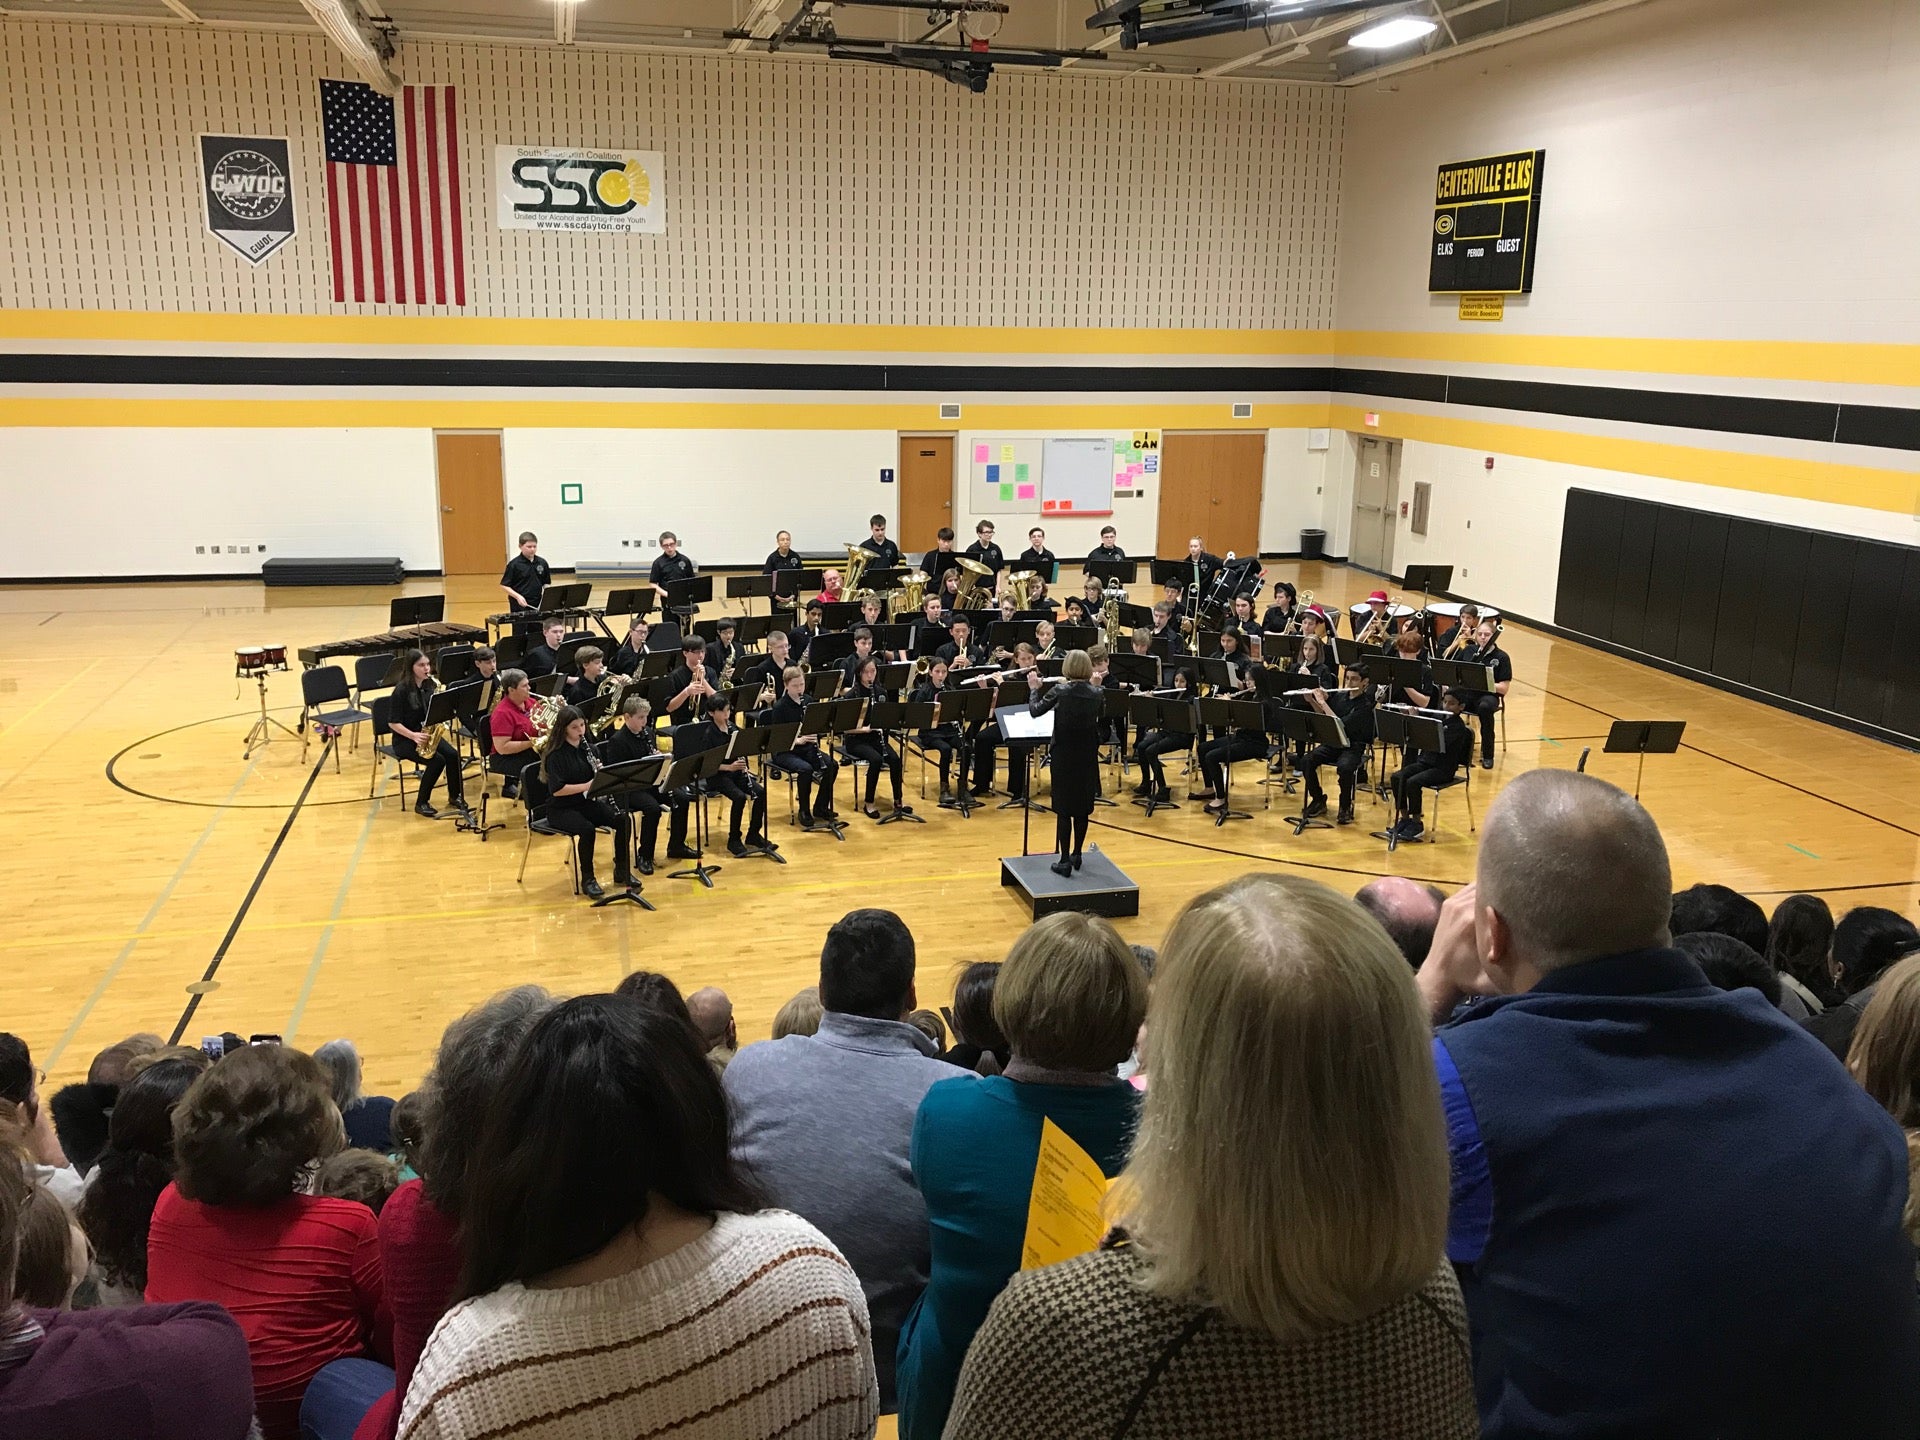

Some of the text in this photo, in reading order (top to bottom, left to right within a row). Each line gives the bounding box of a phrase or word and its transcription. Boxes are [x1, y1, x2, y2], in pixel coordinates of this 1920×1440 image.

[517, 148, 542, 157] South
[586, 150, 623, 160] Coalition
[211, 174, 286, 194] GWOC
[1437, 159, 1532, 199] CENTERVILLE ELKS
[512, 158, 637, 214] SSC
[514, 213, 537, 221] United
[538, 213, 548, 221] for
[550, 214, 574, 222] Alcohol
[590, 216, 626, 224] Drug-Free
[536, 220, 632, 232] www.sscdayton.org
[250, 234, 274, 254] GWOC
[1437, 243, 1454, 256] ELKS
[1496, 238, 1521, 253] GUEST
[1467, 248, 1484, 258] PERIOD
[1144, 432, 1148, 440] I
[1133, 440, 1158, 449] CAN
